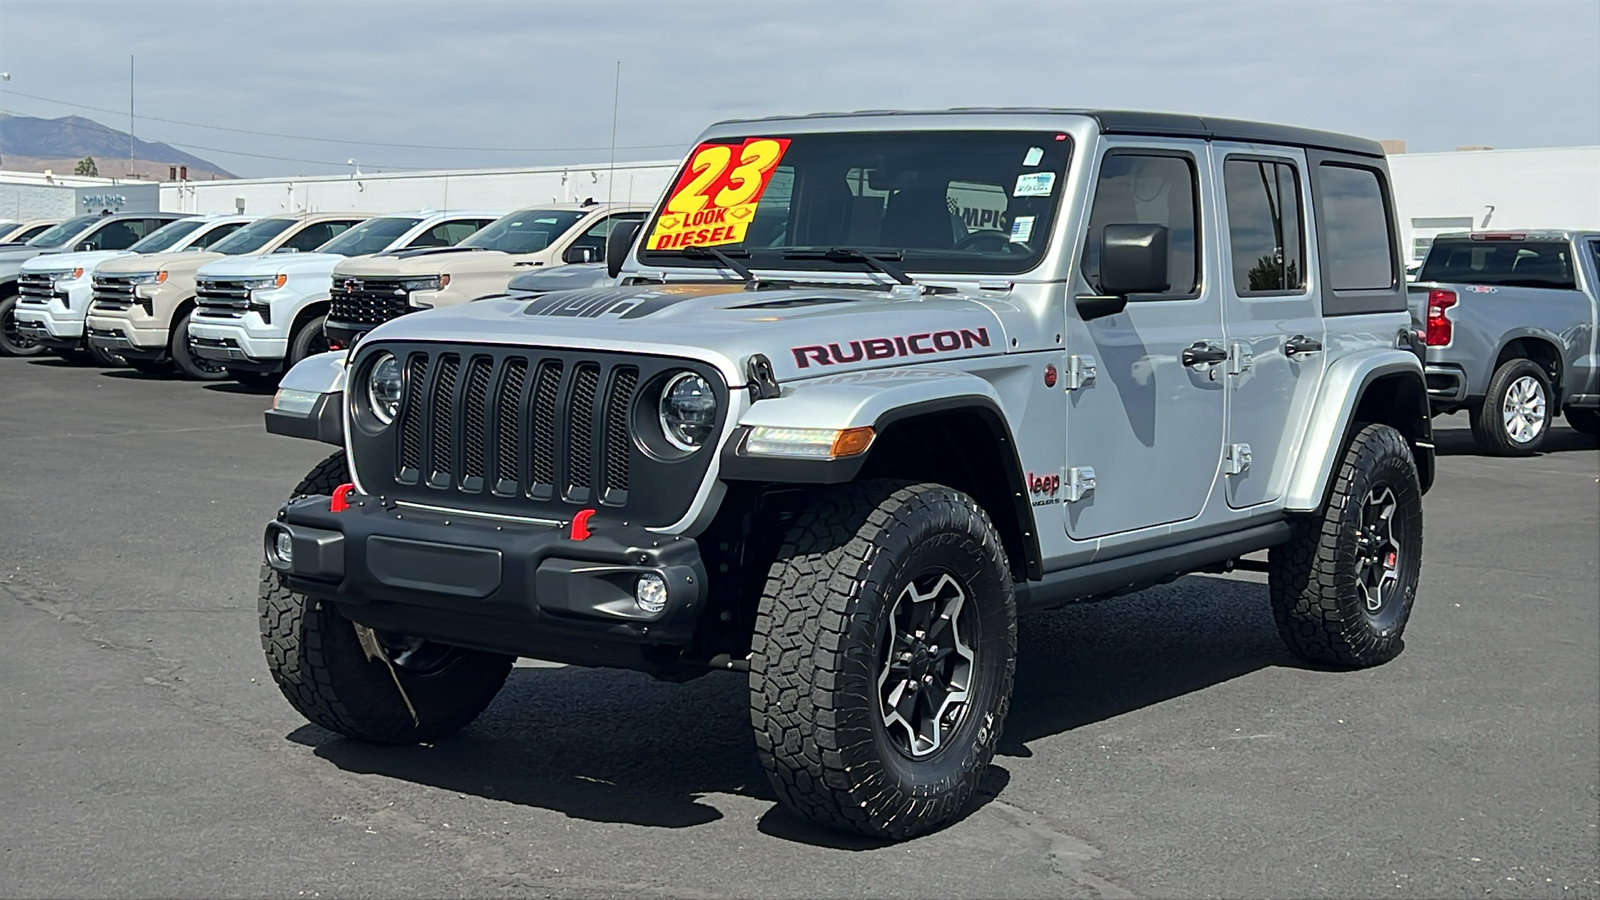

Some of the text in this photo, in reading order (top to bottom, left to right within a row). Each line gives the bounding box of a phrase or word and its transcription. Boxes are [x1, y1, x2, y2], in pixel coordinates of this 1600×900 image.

[668, 140, 781, 213] 23
[683, 208, 730, 228] LOOK
[656, 226, 735, 250] DIESEL
[791, 327, 990, 369] RUBICON
